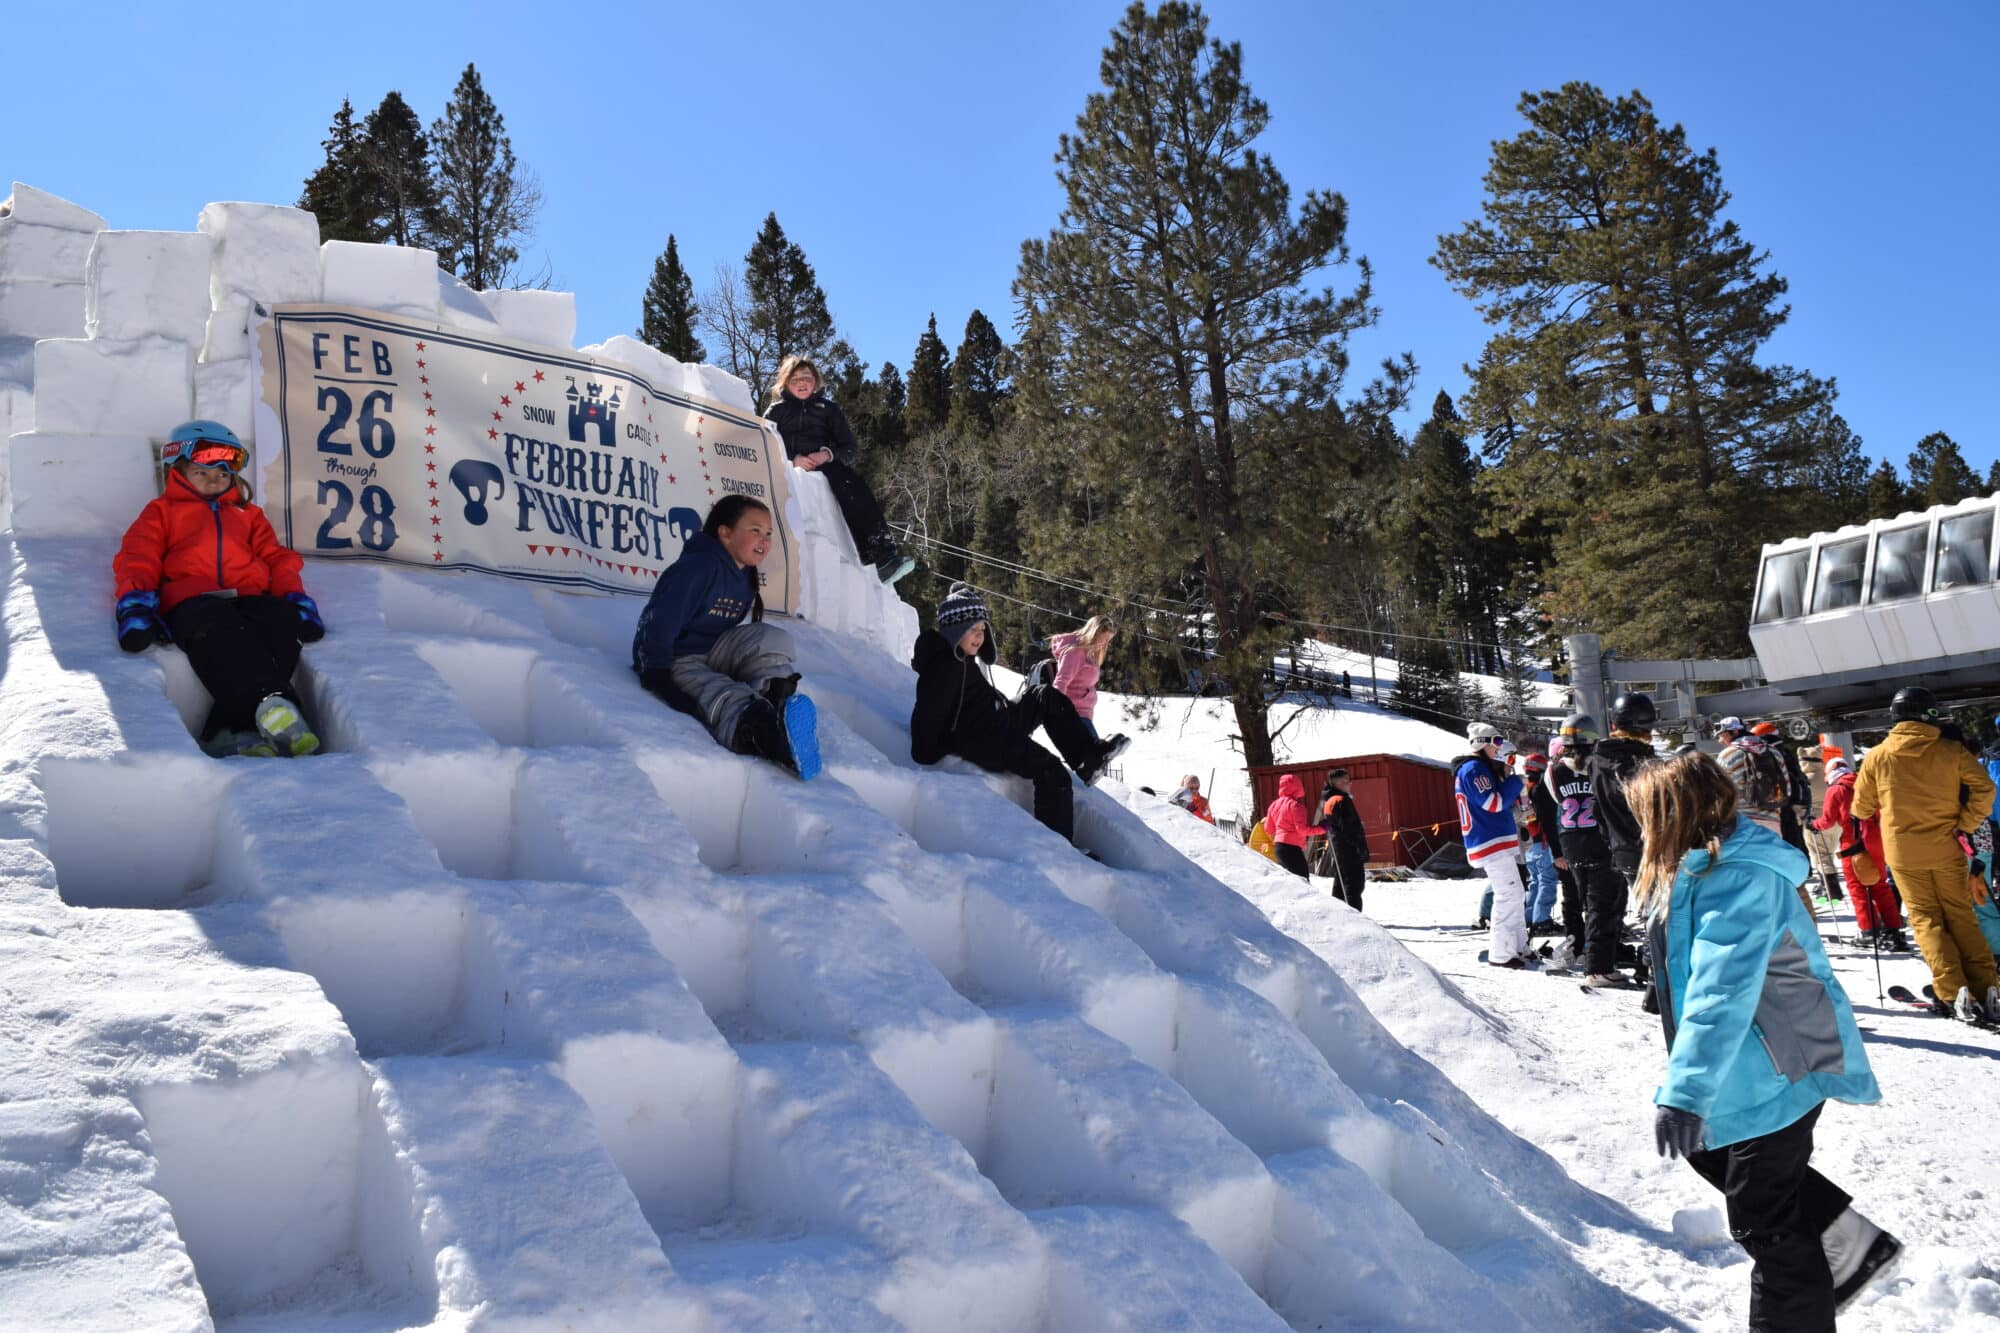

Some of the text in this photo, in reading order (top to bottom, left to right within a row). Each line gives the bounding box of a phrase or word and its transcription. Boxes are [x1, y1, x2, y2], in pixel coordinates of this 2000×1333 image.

[312, 333, 393, 376] FEB
[316, 386, 396, 459] 26
[523, 405, 652, 447] SNOW CASTLE
[324, 457, 378, 485] through
[503, 431, 660, 509] FEBRUARY
[714, 442, 758, 463] COSTUMES
[721, 476, 766, 498] SCAVENGER
[316, 479, 399, 551] 28
[513, 480, 668, 561] FUNFEST
[1560, 798, 1598, 829] 22
